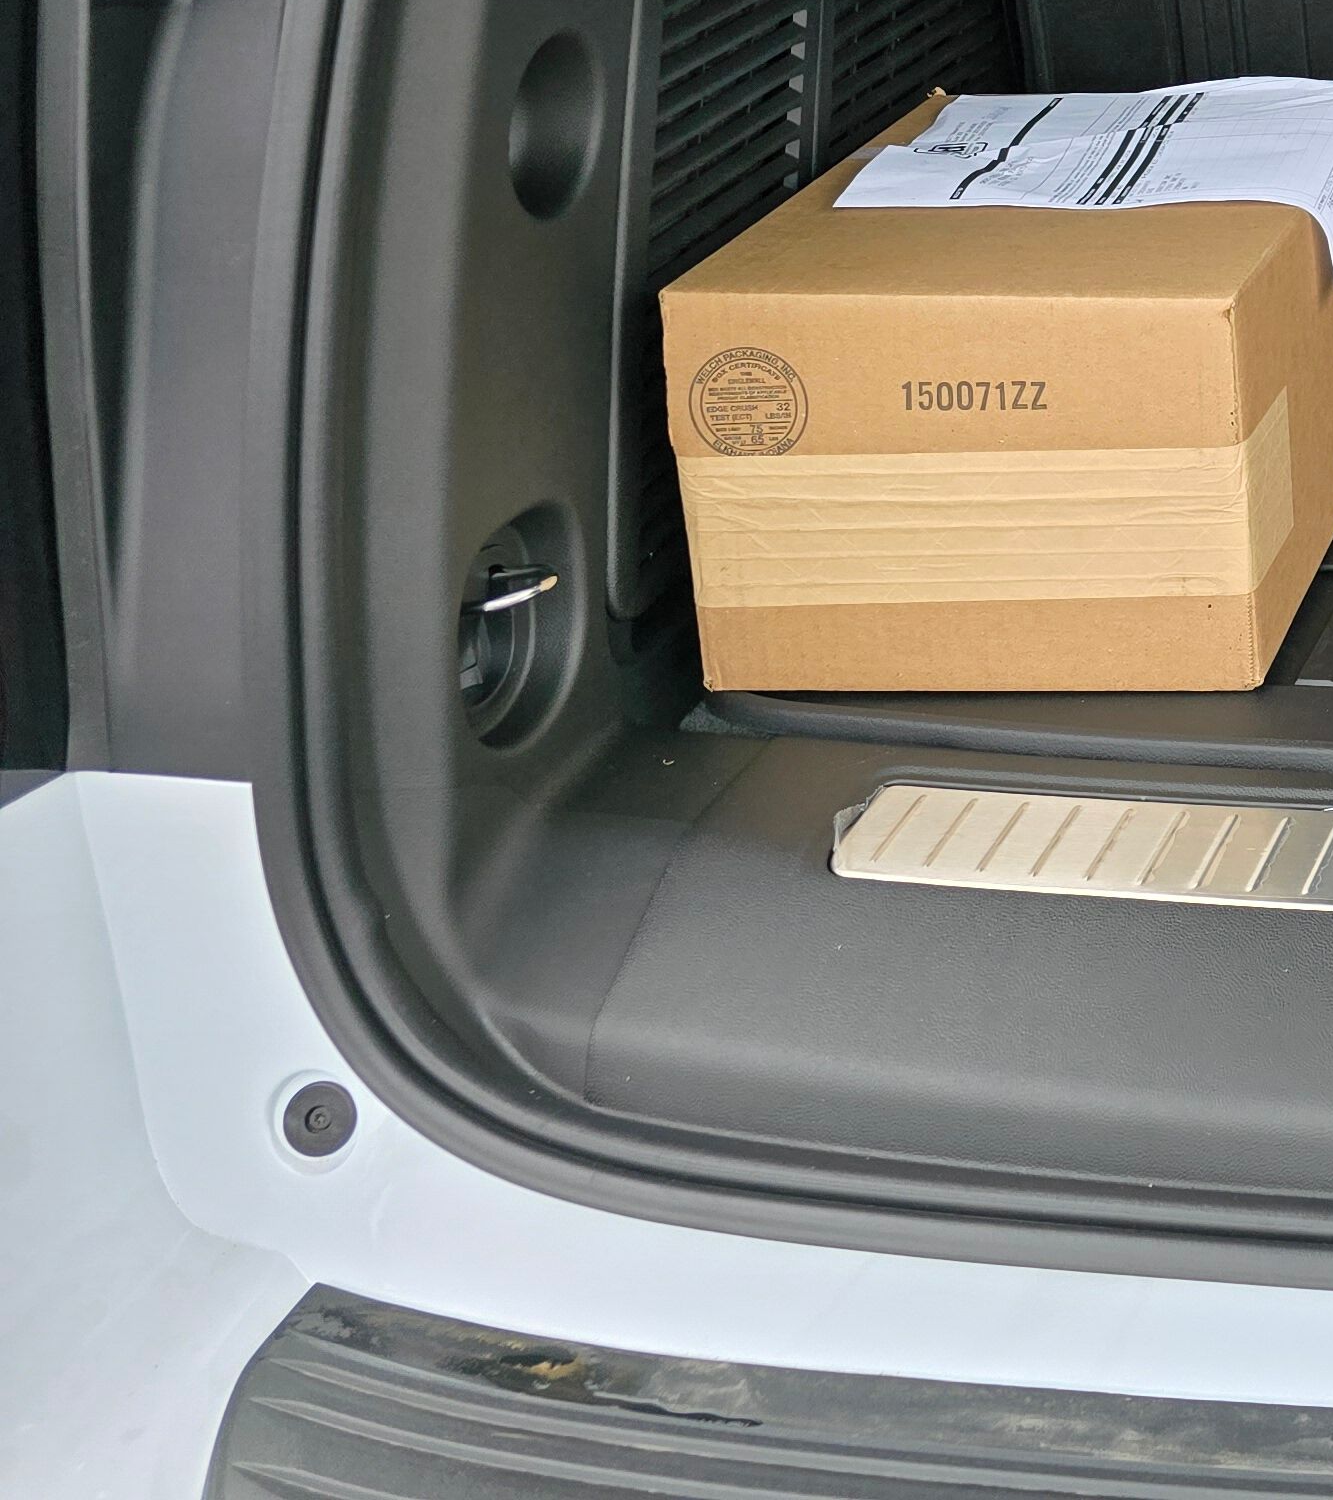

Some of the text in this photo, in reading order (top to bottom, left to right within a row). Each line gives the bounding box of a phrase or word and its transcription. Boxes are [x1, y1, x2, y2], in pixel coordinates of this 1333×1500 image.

[696, 350, 796, 384] WELCH PACKAGING, INC.
[712, 362, 781, 382] BOX CERTIFICATE
[901, 380, 1049, 411] 150071ZZ
[776, 403, 790, 411] 32
[732, 414, 752, 422] (ECT)
[750, 424, 764, 434] 75
[751, 435, 764, 444] 65
